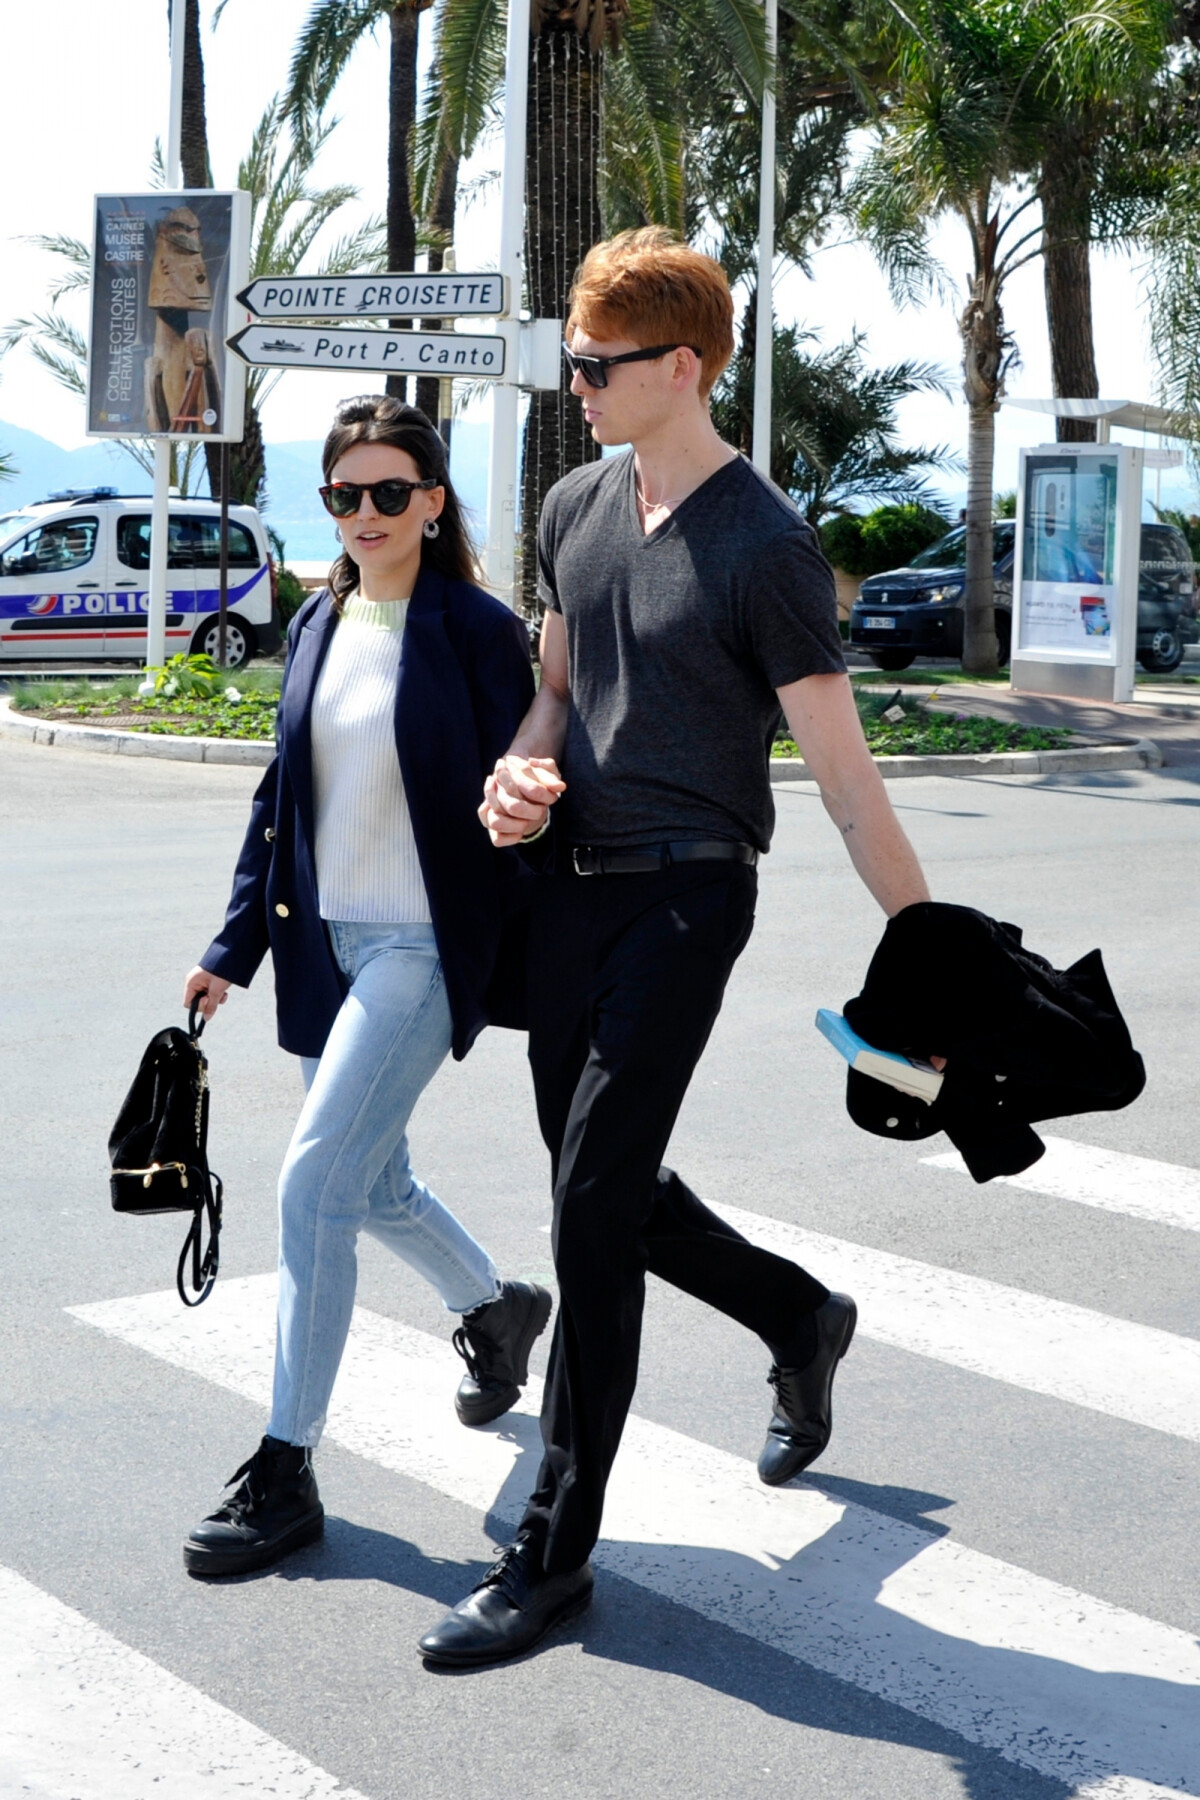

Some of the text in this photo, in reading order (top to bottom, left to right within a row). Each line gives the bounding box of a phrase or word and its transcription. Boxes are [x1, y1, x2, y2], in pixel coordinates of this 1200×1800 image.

[105, 222, 145, 231] CANNES
[104, 250, 145, 262] CASTRE
[263, 284, 492, 307] POINTE CROISETTE
[107, 278, 124, 402] COLLECTIONS
[120, 277, 136, 402] PERMANENTES
[314, 338, 494, 366] Port P. Canto
